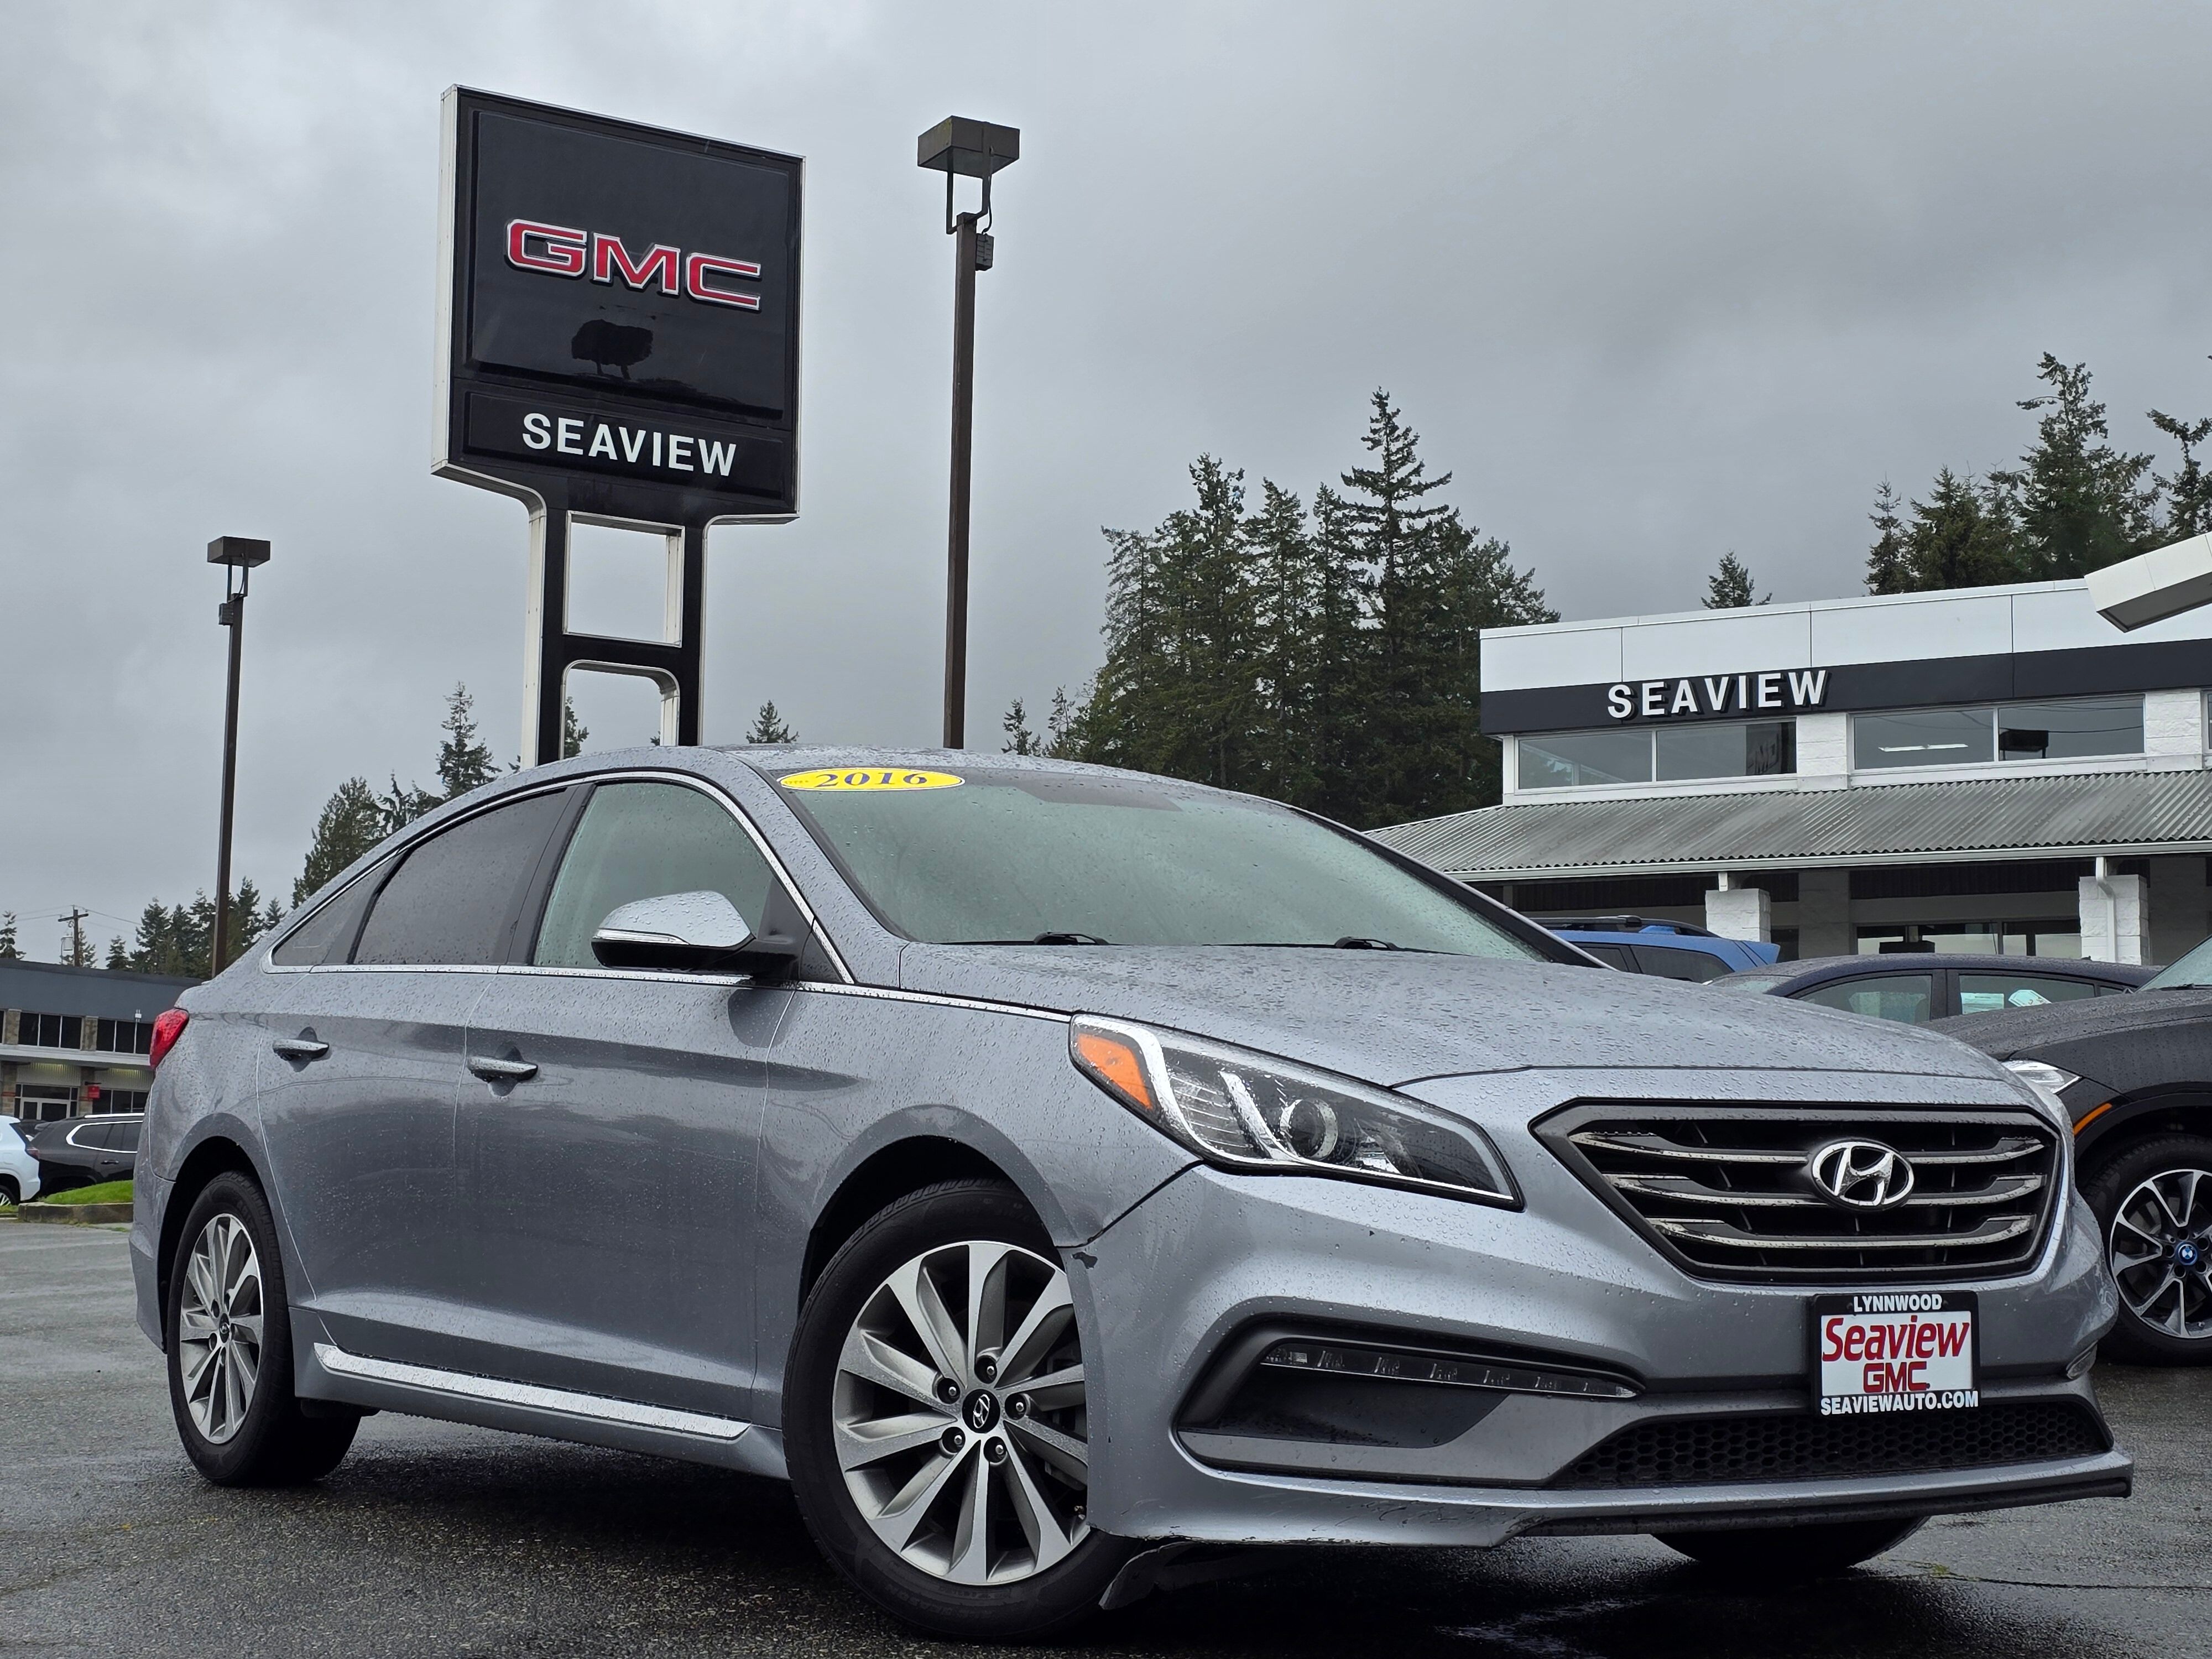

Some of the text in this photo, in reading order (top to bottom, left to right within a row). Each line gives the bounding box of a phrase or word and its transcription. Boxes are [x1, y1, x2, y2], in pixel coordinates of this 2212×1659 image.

[506, 219, 761, 310] GMC
[523, 413, 736, 476] SEAVIEW
[1608, 670, 1827, 718] SEAVIEW
[815, 771, 927, 787] 2016
[1853, 1294, 1943, 1312] LYNNWOOD
[1822, 1315, 1970, 1361] Seaview
[1863, 1361, 1927, 1393] GMC
[1821, 1391, 1979, 1416] SEAVIEWAUTO.COM
